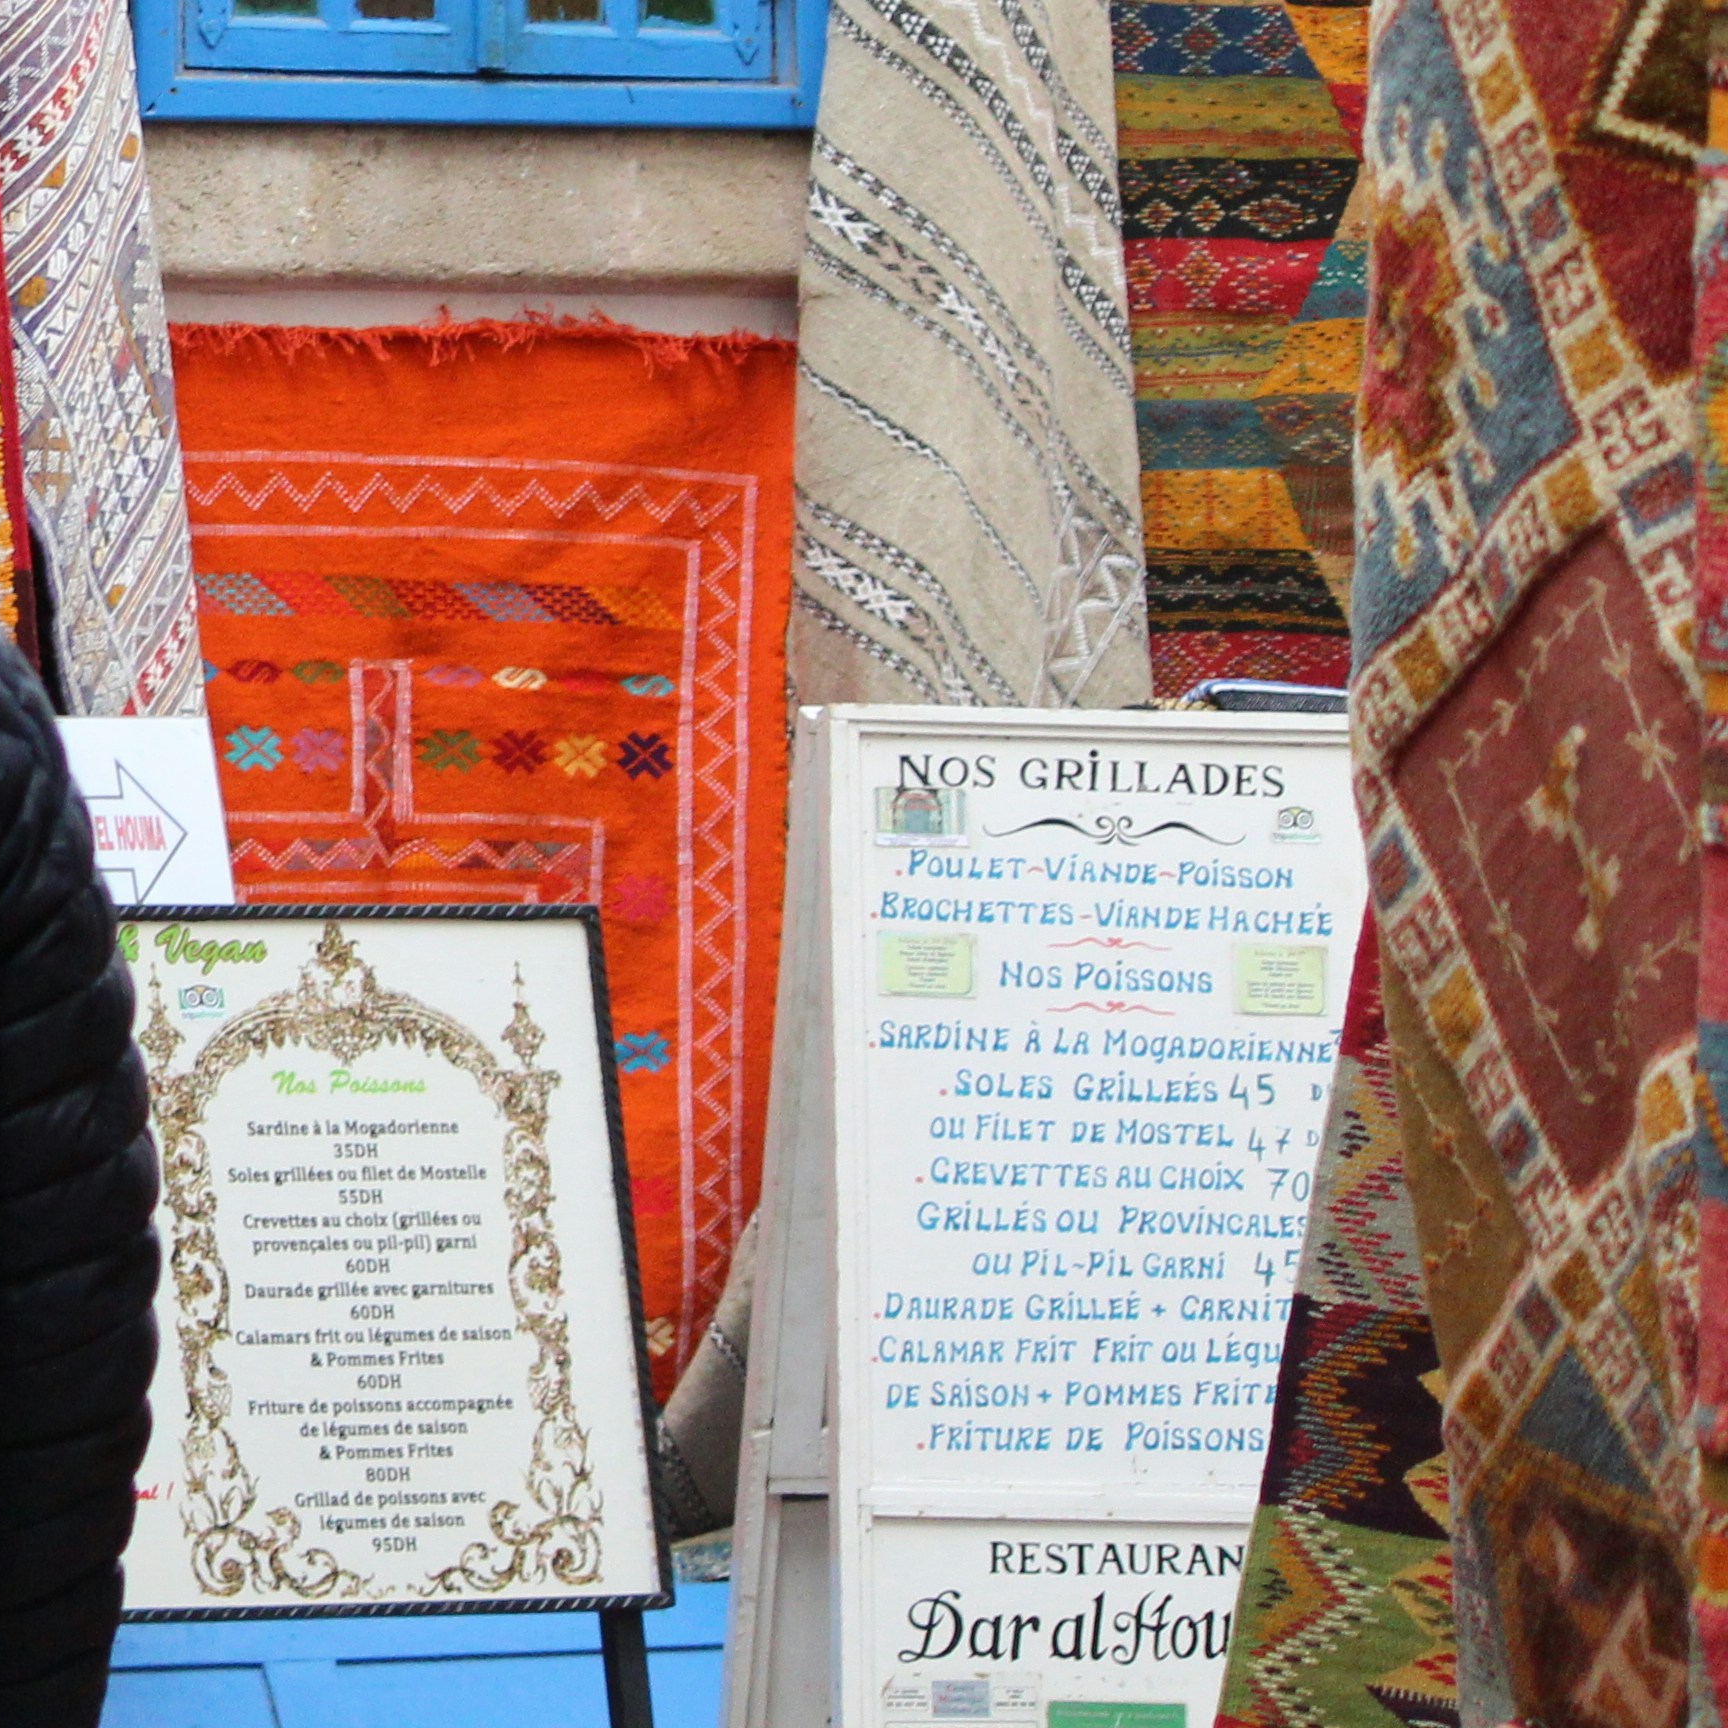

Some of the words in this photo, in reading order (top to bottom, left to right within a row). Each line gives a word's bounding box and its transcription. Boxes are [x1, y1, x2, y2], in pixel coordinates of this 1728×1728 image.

[895, 755, 995, 793] NOS
[1020, 753, 1284, 797] GRILLADES
[114, 815, 167, 851] HOUMA
[155, 923, 267, 976] Vegan
[272, 1070, 316, 1095] Nos
[329, 1069, 426, 1094] Poissons
[247, 1121, 308, 1136] Sardine
[313, 1121, 321, 1135] à
[326, 1120, 340, 1135] la
[345, 1120, 458, 1139] Mogadorienne
[334, 1143, 378, 1158] 35DH
[228, 1167, 270, 1183] Soles
[274, 1166, 333, 1186] grillées
[338, 1170, 357, 1181] ou
[362, 1166, 393, 1181] filet
[397, 1165, 416, 1180] de
[420, 1165, 486, 1180] Mostelle
[339, 1189, 383, 1204] 55DH
[243, 1214, 317, 1229] Crevettes
[322, 1217, 341, 1227] au
[345, 1213, 388, 1227] choix
[393, 1211, 458, 1230] (grillées
[462, 1215, 481, 1225] ou
[253, 1236, 349, 1256] provençales
[353, 1239, 373, 1250] ou
[377, 1235, 431, 1254] pil-pil)
[436, 1235, 477, 1253] garni
[346, 1258, 390, 1273] 60DH
[245, 1283, 313, 1299] Daurade
[318, 1282, 368, 1301] grillée
[374, 1285, 407, 1296] avec
[412, 1282, 494, 1299] garnitures
[989, 1541, 1245, 1576] RESTAURAN
[898, 1590, 1040, 1663] Dar
[1049, 1591, 1108, 1660] al
[1112, 1591, 1231, 1665] Hou
